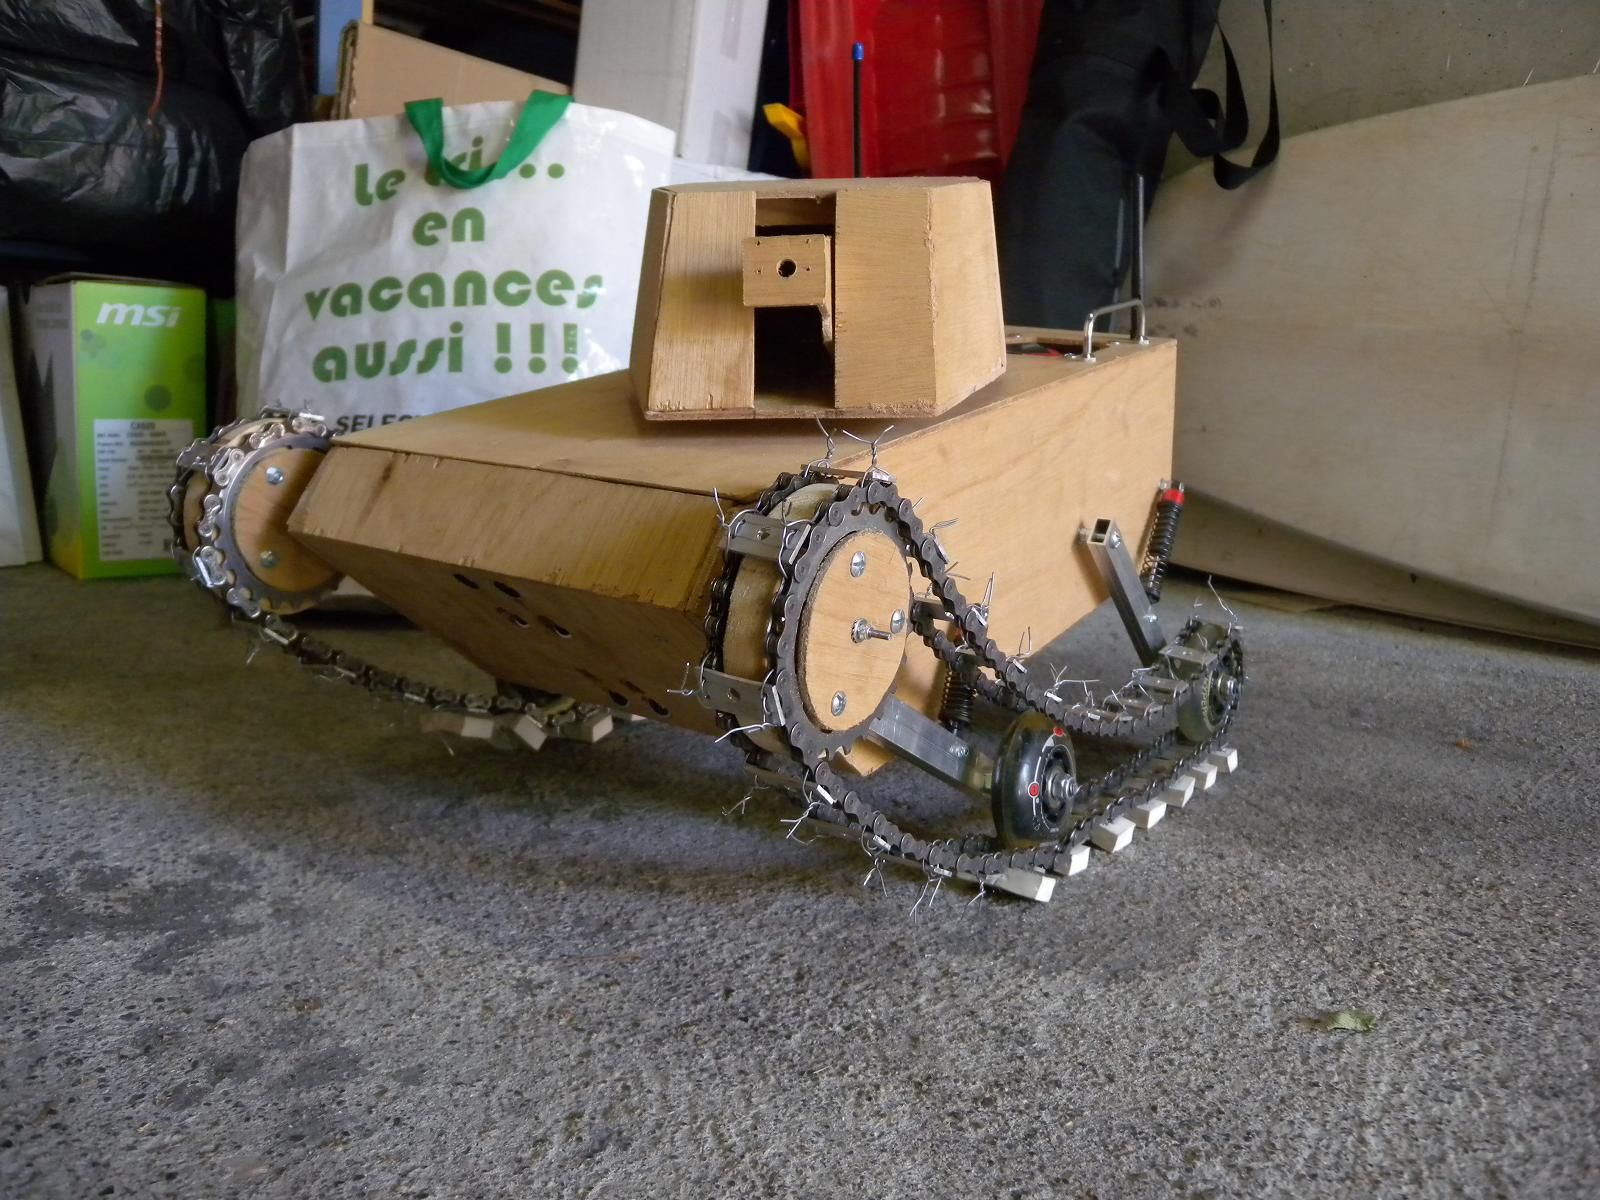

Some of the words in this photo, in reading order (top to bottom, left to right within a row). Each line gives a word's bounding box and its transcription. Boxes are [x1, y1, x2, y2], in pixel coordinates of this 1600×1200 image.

[413, 207, 485, 246] en
[97, 303, 181, 327] msi
[305, 269, 604, 321] vacances
[312, 321, 464, 383] aussi
